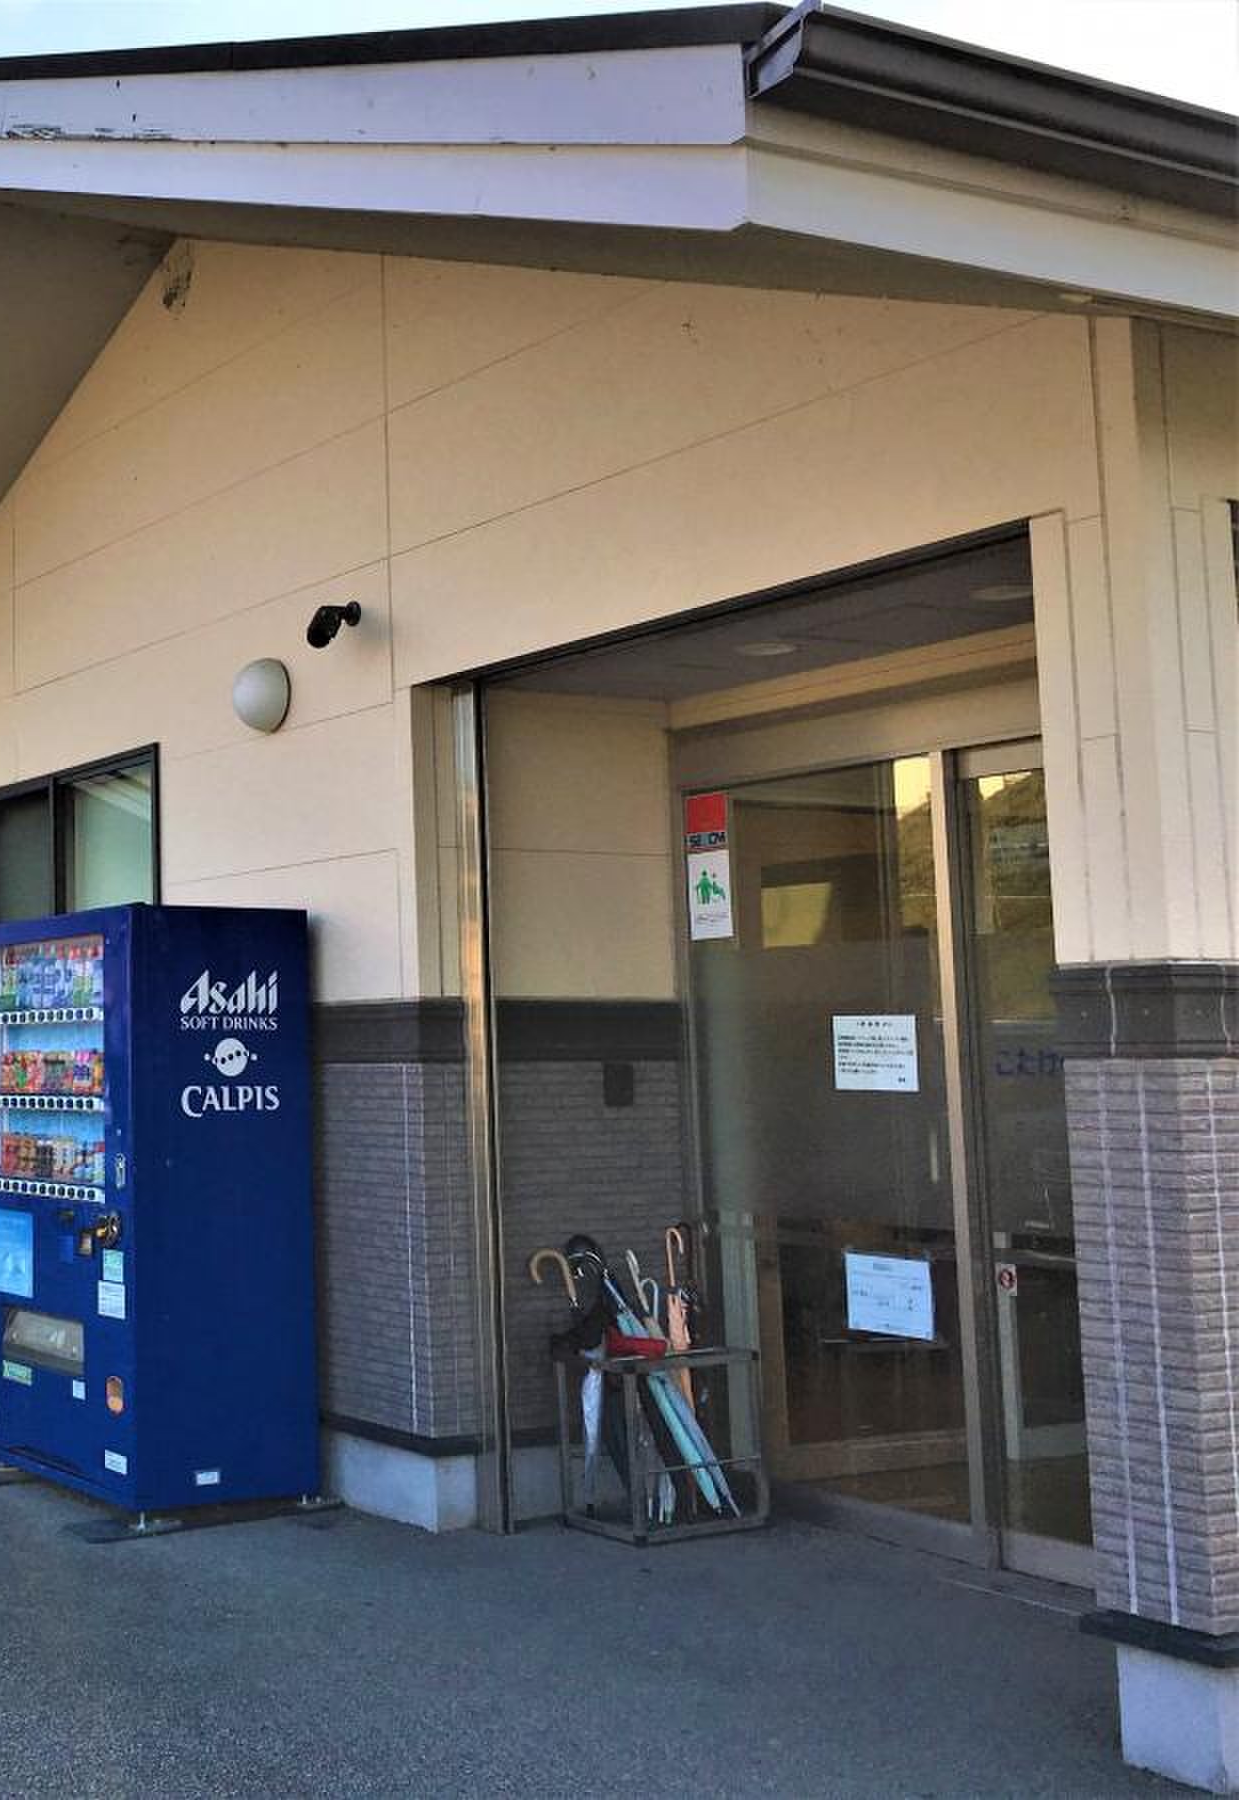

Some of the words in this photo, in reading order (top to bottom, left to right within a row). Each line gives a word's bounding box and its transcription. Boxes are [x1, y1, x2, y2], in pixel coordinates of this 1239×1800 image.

[180, 969, 278, 1014] Asahi
[180, 1015, 219, 1030] SOFT
[223, 1015, 278, 1030] DRINKS
[181, 1085, 280, 1118] CALPIS
